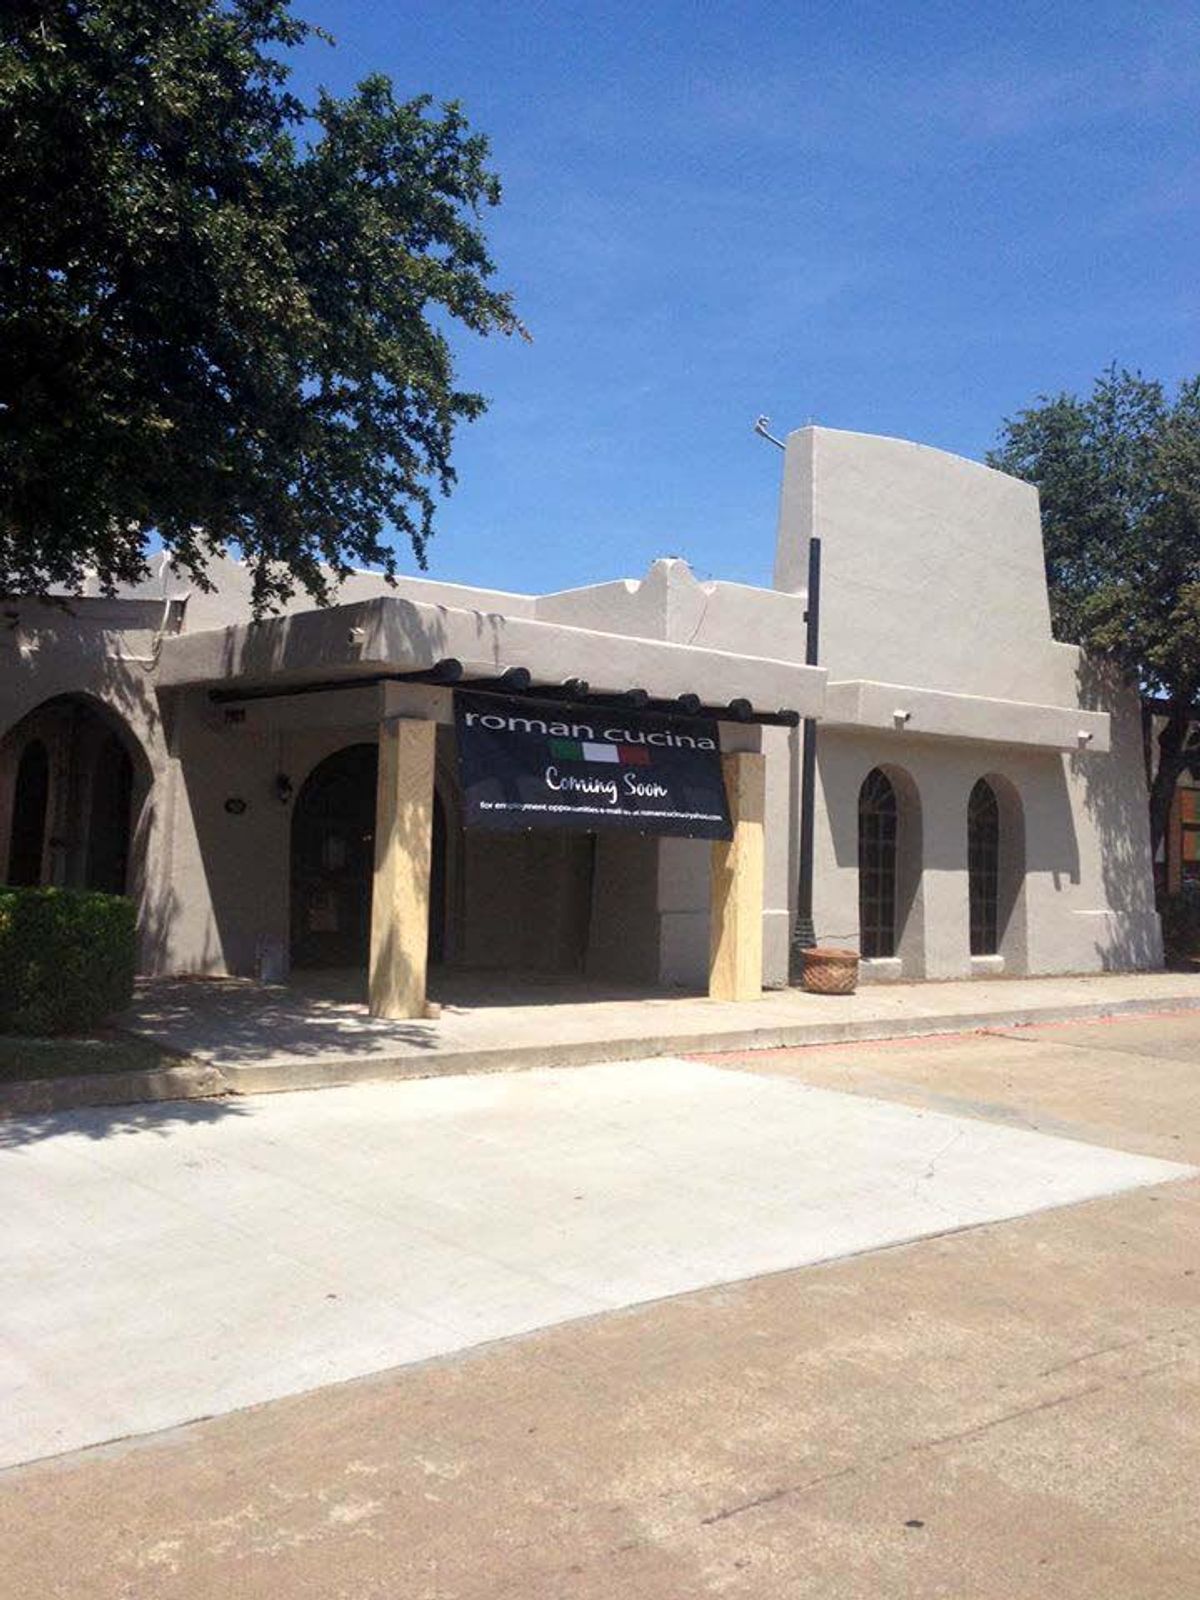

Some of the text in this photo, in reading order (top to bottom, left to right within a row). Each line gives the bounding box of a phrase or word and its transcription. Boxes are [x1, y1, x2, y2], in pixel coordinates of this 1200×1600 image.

[465, 711, 716, 750] roman cucina
[545, 766, 669, 804] Coming Soon
